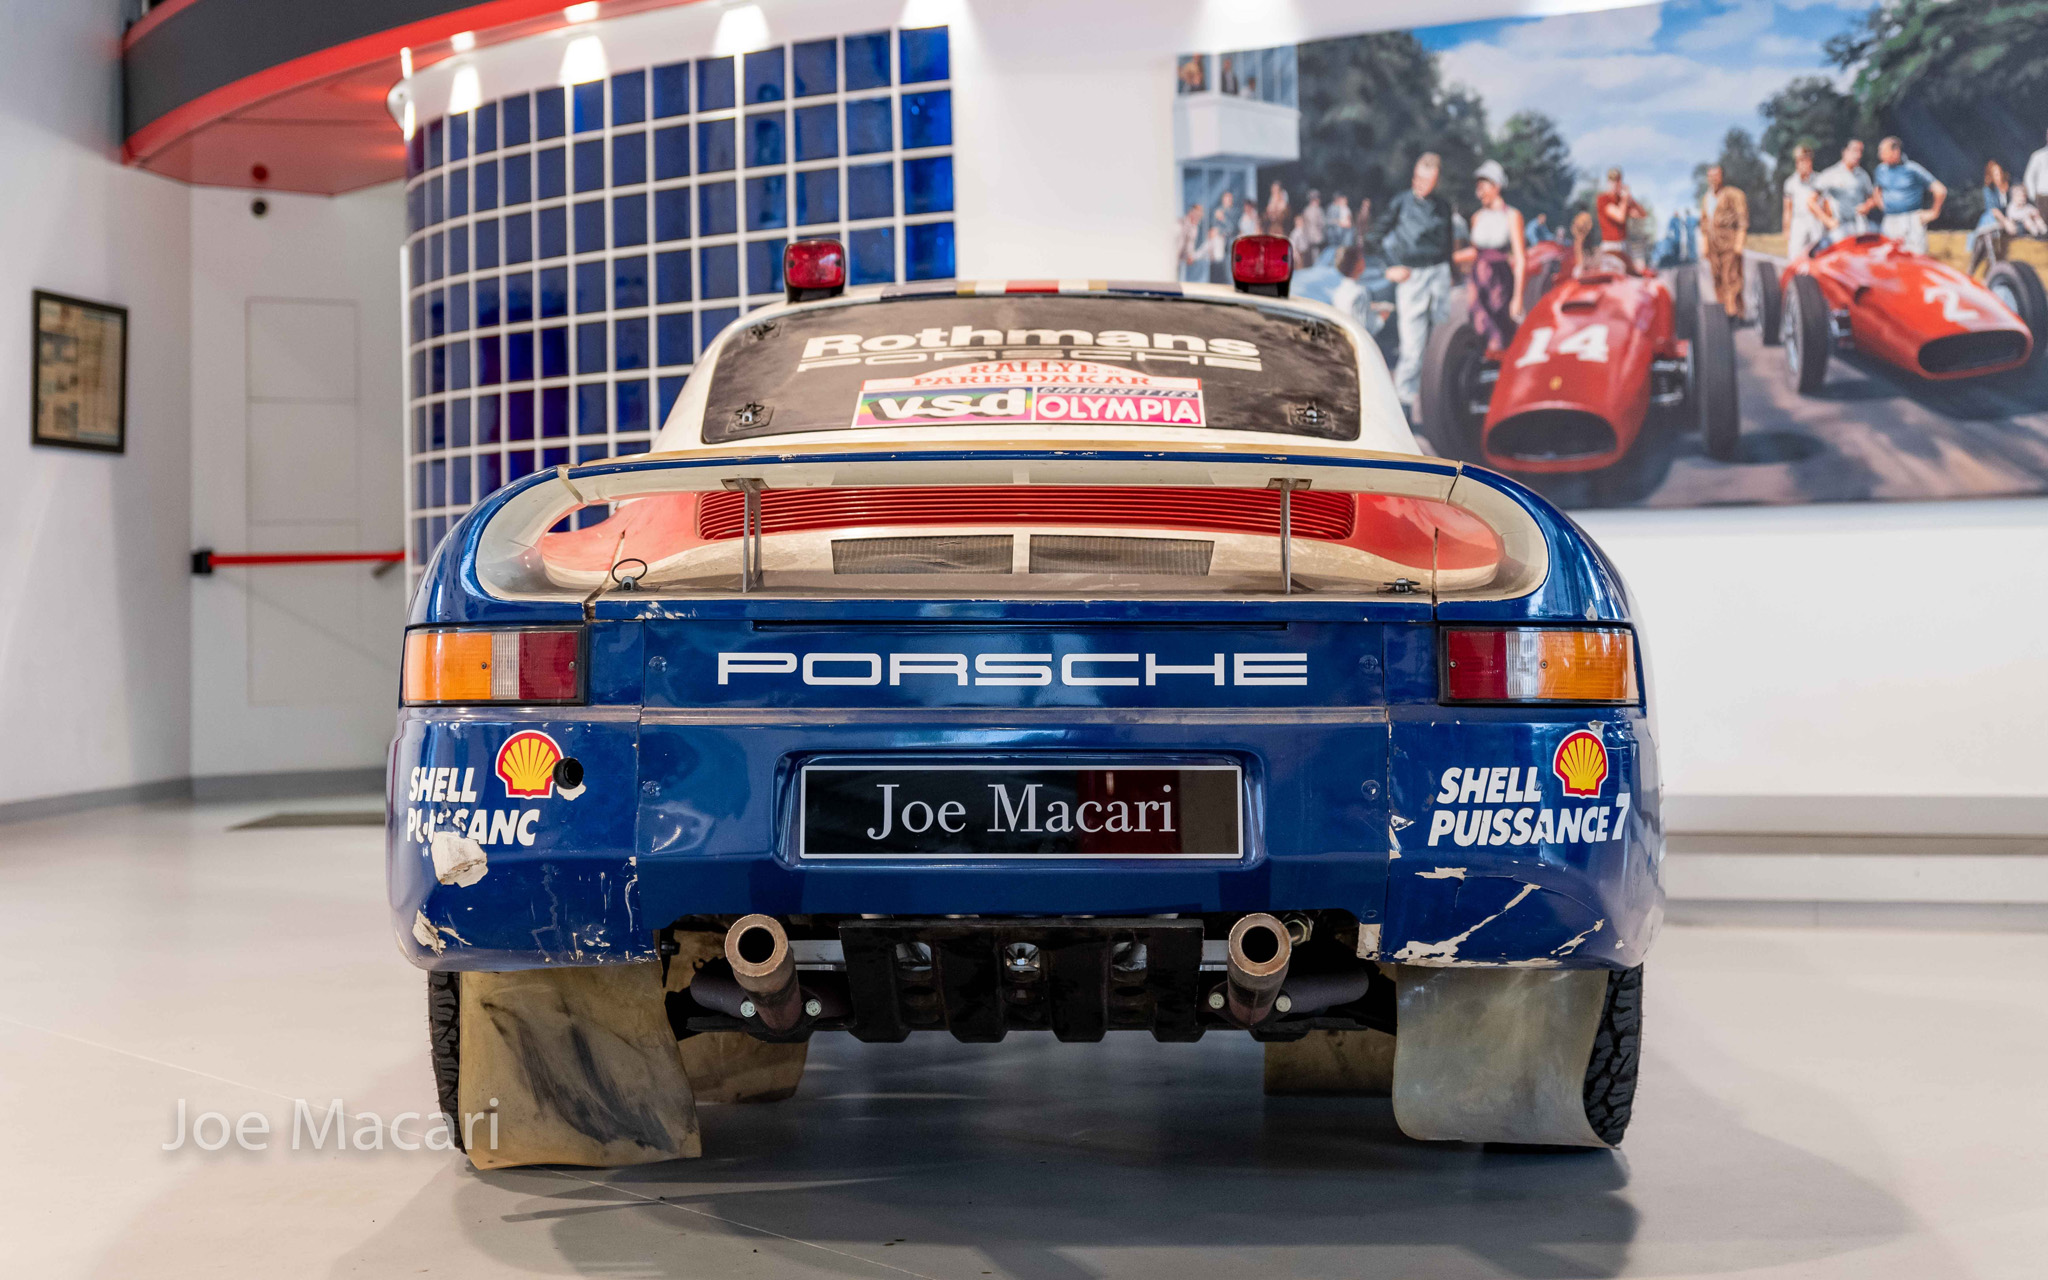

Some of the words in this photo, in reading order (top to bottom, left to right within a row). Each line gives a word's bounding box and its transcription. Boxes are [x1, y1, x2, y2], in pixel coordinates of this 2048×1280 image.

[802, 325, 1260, 358] Rothmans
[1515, 323, 1609, 368] 14
[797, 348, 1263, 372] PORSCHE
[970, 361, 1098, 373] RALLYE
[913, 374, 1152, 386] PARIS-DAKAR
[877, 388, 1027, 420] vsd
[1037, 396, 1199, 422] OLYMPIA
[718, 652, 1307, 686] PORSCHE
[408, 767, 477, 802] SHELL
[1436, 766, 1542, 804] SHELL
[867, 784, 967, 840] Joe
[987, 784, 1177, 833] Macari
[1427, 806, 1610, 846] PUISSANCE
[1612, 792, 1631, 840] 7
